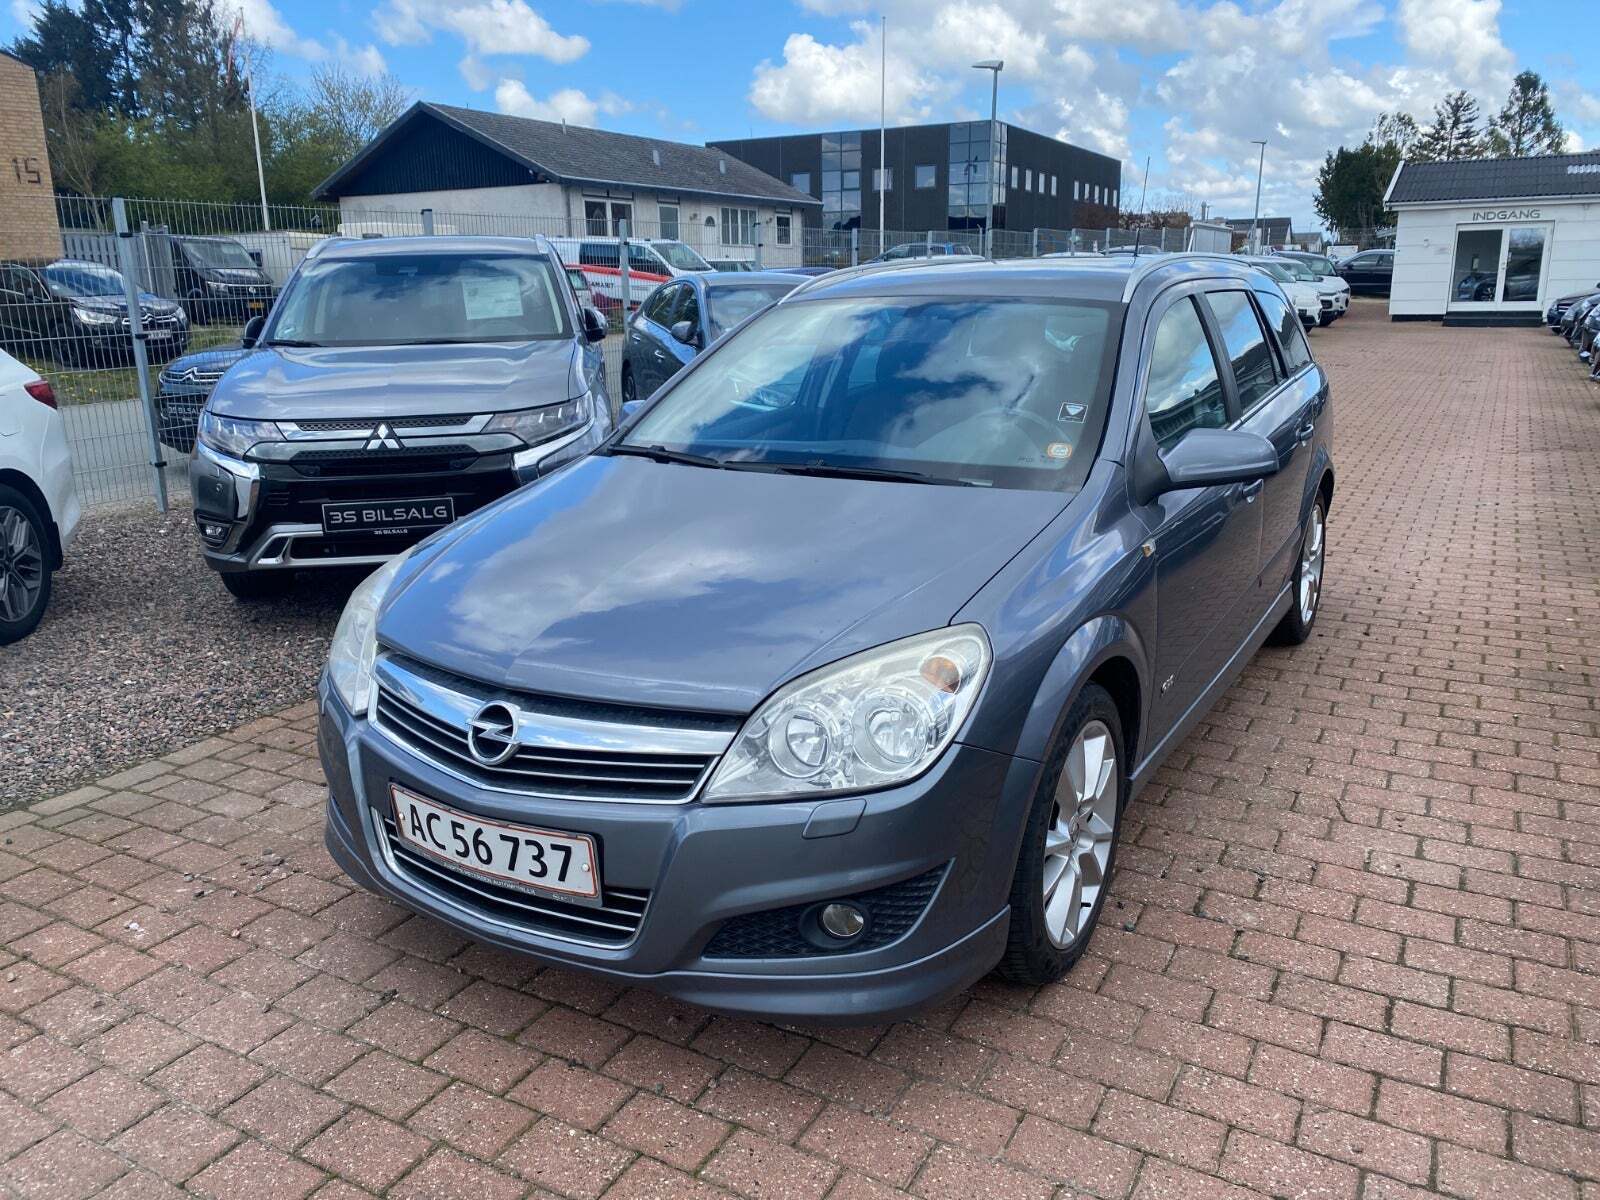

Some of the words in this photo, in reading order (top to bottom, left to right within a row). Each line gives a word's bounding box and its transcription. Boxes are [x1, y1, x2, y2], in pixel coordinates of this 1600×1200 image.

[11, 156, 41, 184] 15
[1472, 208, 1541, 221] INDGANG
[329, 511, 357, 524] 3S
[362, 505, 448, 522] BILSALG
[409, 804, 446, 851] AC
[451, 820, 493, 865] 56
[499, 833, 572, 882] 737
